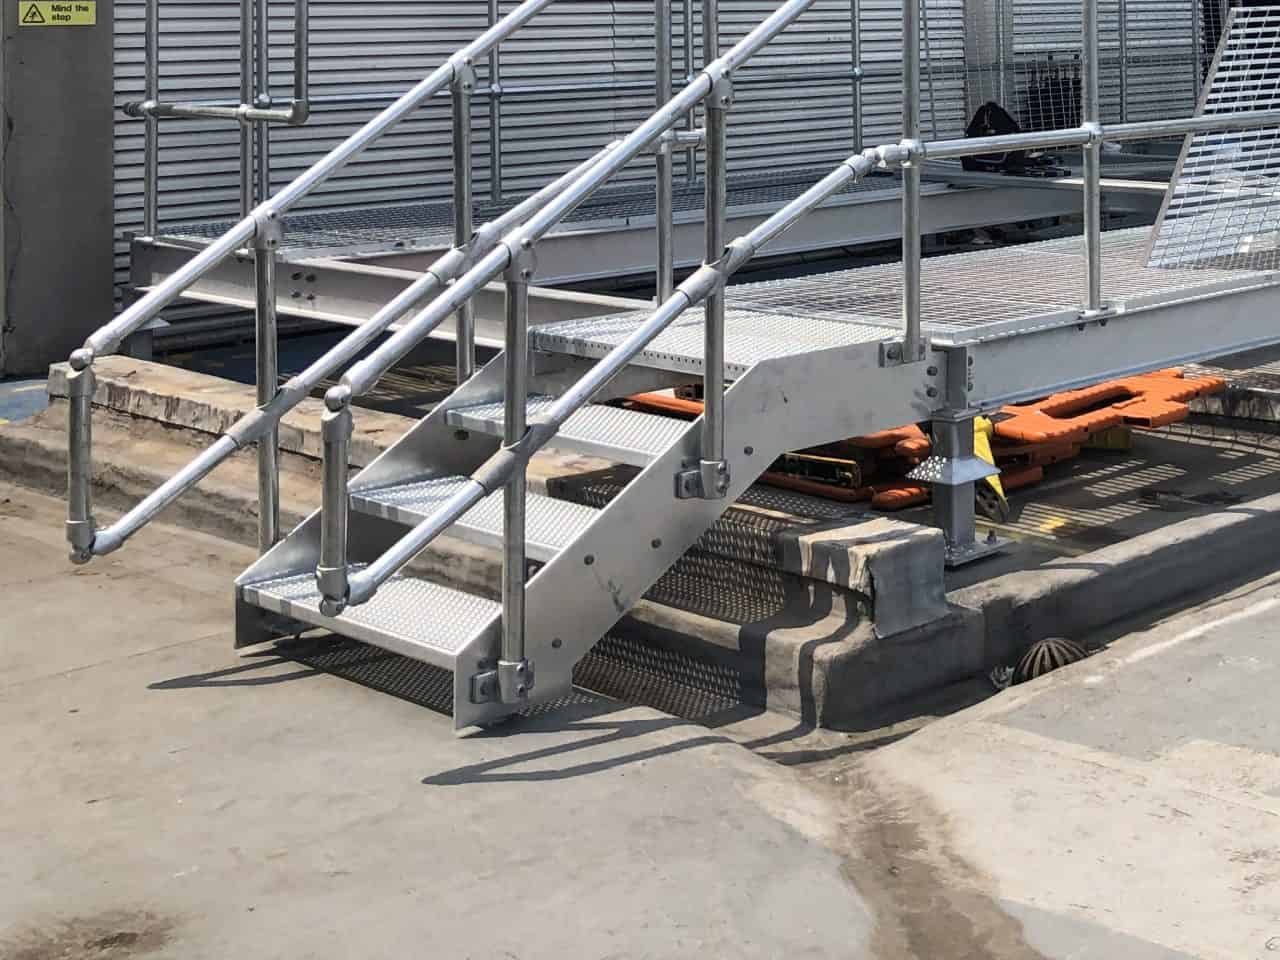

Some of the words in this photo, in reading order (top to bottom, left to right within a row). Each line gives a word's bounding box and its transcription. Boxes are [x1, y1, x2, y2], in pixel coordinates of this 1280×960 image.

[51, 4, 72, 12] Mind
[75, 4, 89, 12] the
[51, 14, 71, 22] step
